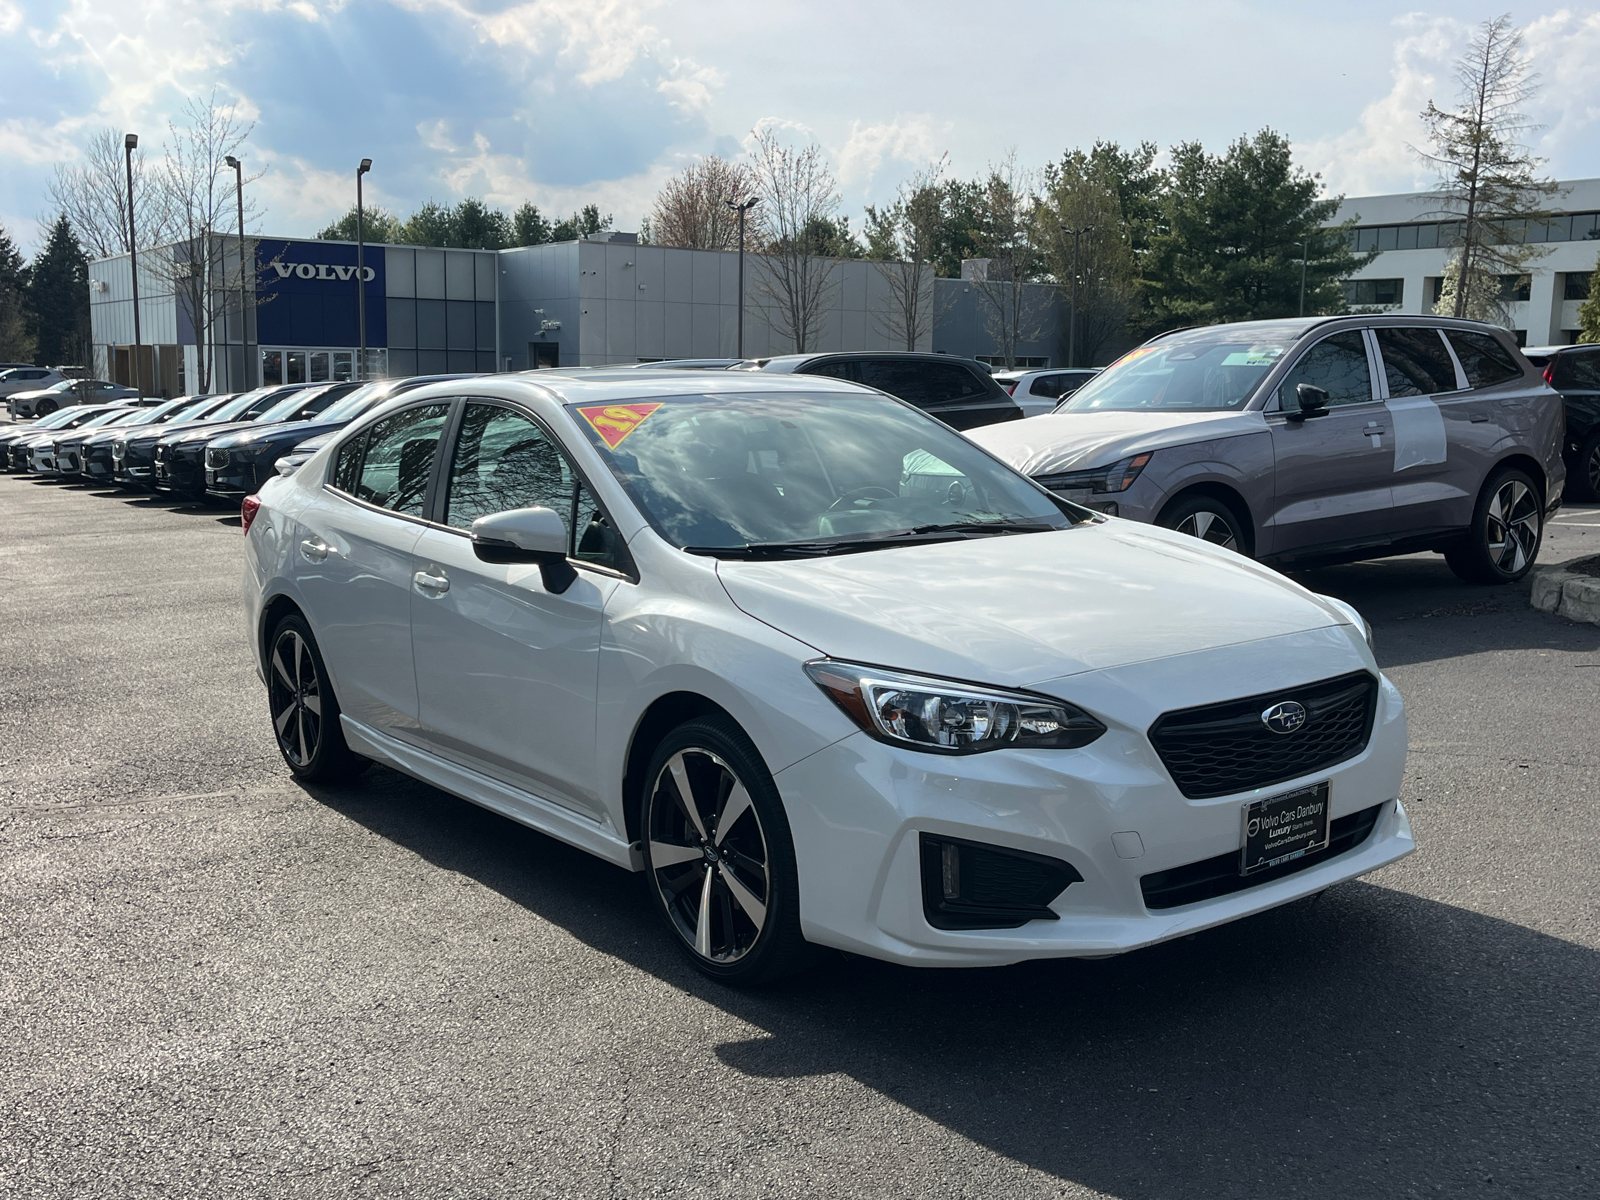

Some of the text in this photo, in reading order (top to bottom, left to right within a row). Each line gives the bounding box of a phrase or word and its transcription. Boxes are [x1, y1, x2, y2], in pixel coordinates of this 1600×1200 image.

[273, 262, 376, 282] VOLVO
[593, 406, 642, 432] 19
[1261, 815, 1279, 829] Volvo
[1280, 811, 1296, 823] Cars
[1296, 802, 1324, 818] Danbury
[1264, 829, 1317, 850] VolvoCarsDanbury.com
[1269, 825, 1292, 838] Luxury
[1269, 859, 1280, 867] VOLVO
